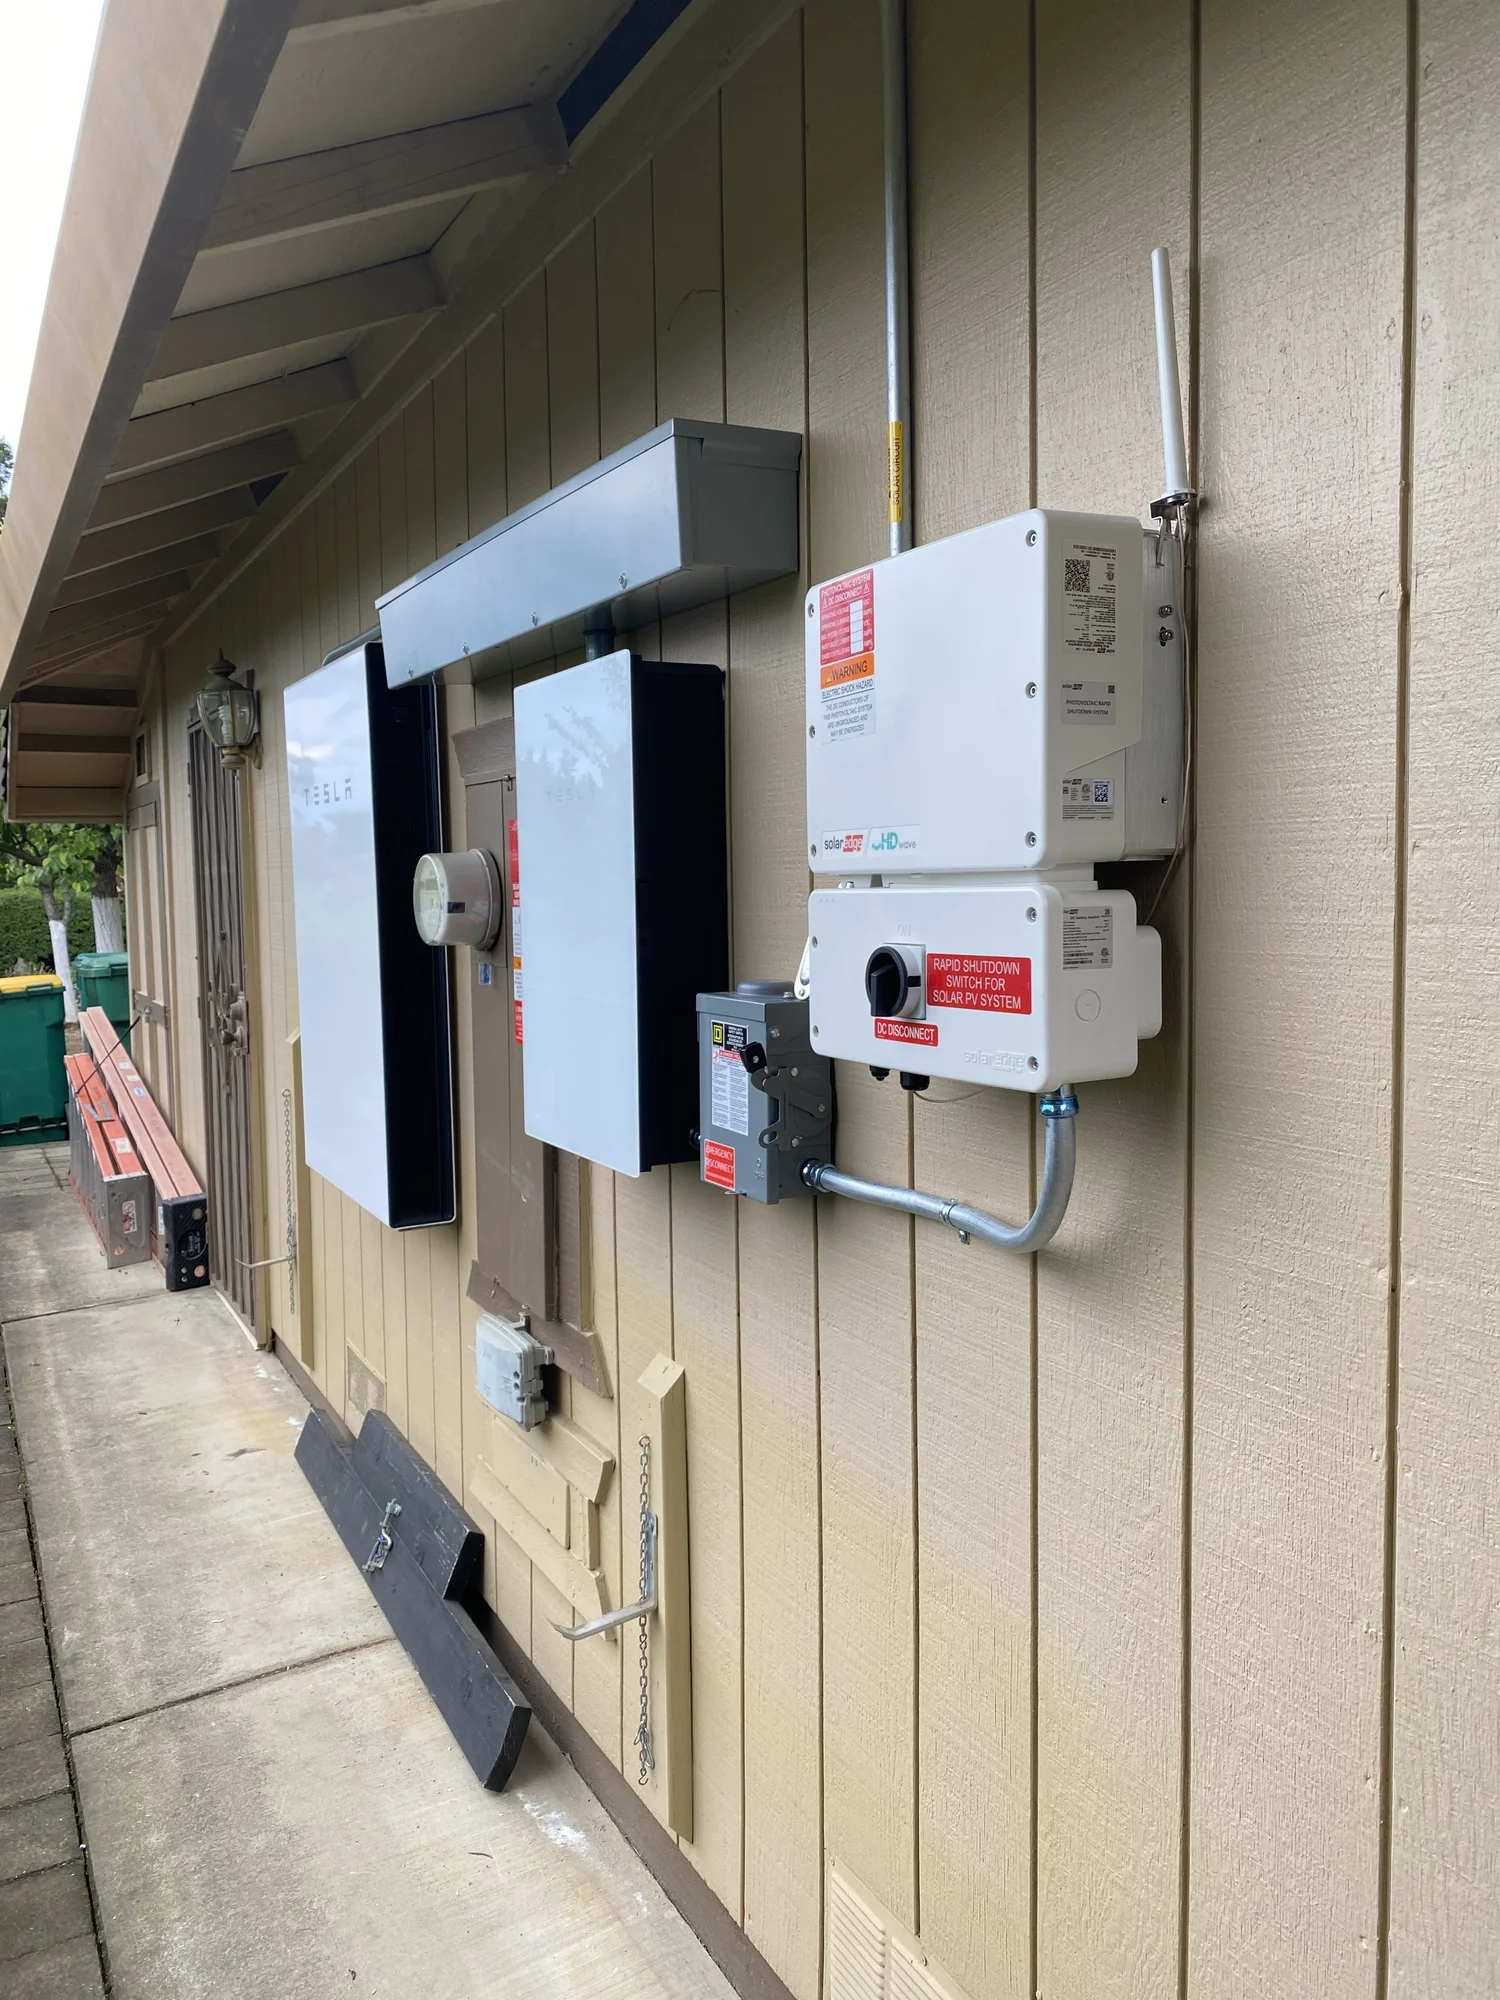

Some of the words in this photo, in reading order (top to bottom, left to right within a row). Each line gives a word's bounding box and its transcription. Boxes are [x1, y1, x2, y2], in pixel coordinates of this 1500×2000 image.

[821, 580, 852, 598] PHOTOVOLTAIC
[852, 572, 871, 587] SYSTEM
[828, 597, 835, 606] DC
[834, 586, 863, 604] DISCONNECT
[832, 660, 868, 680] WARNING
[821, 686, 840, 699] ELECTRIC
[841, 683, 856, 694] SHOCK
[856, 679, 873, 690] HAZARD
[838, 697, 863, 708] CONDUCTORS
[857, 703, 873, 713] SYSTEM
[835, 716, 860, 727] UNGROUNDED
[303, 777, 352, 807] TESLA
[545, 784, 595, 806] TESLA
[824, 834, 864, 853] solaredge
[899, 840, 917, 849] wave
[897, 923, 911, 936] ON
[933, 957, 961, 972] RAPID
[962, 959, 1020, 976] SHUTDOWN
[945, 974, 982, 990] SWITCH
[984, 977, 1006, 991] FOR
[933, 989, 963, 1005] SOLAR
[965, 992, 979, 1006] PV
[980, 993, 1021, 1010] SYSTEM
[877, 1022, 887, 1035] DC
[888, 1024, 935, 1041] DISCONNECT
[964, 1048, 1027, 1073] solaredge
[705, 1144, 733, 1161] EMERGENCY
[705, 1157, 733, 1174] DISCONNECT
